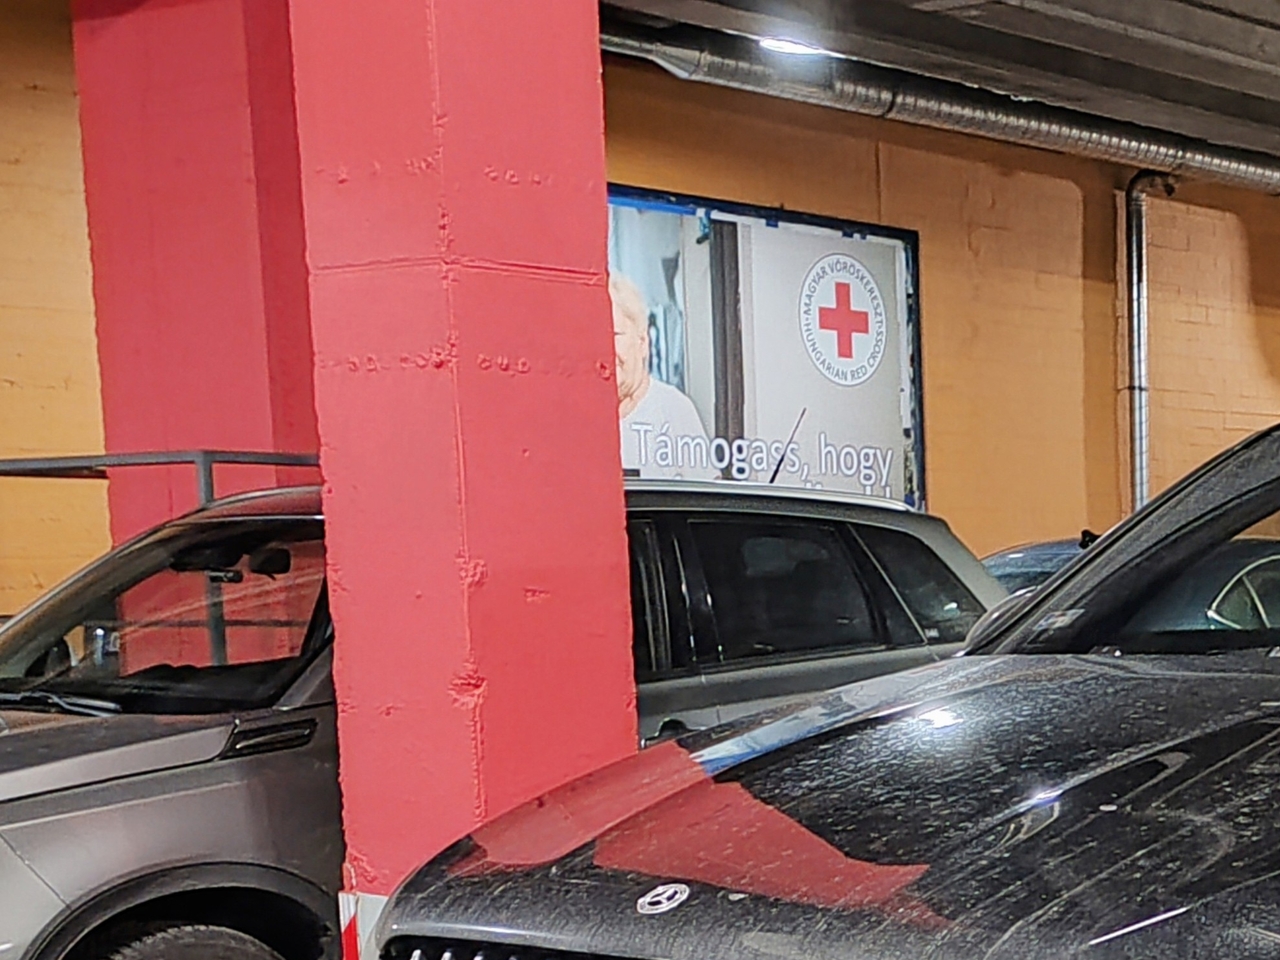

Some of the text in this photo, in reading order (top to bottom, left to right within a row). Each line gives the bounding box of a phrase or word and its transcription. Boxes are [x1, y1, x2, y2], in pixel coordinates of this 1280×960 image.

[803, 266, 828, 317] MAGYAR
[803, 322, 884, 381] HUNGARIAN RED CROSS
[630, 422, 894, 488] Támogass, hogy
